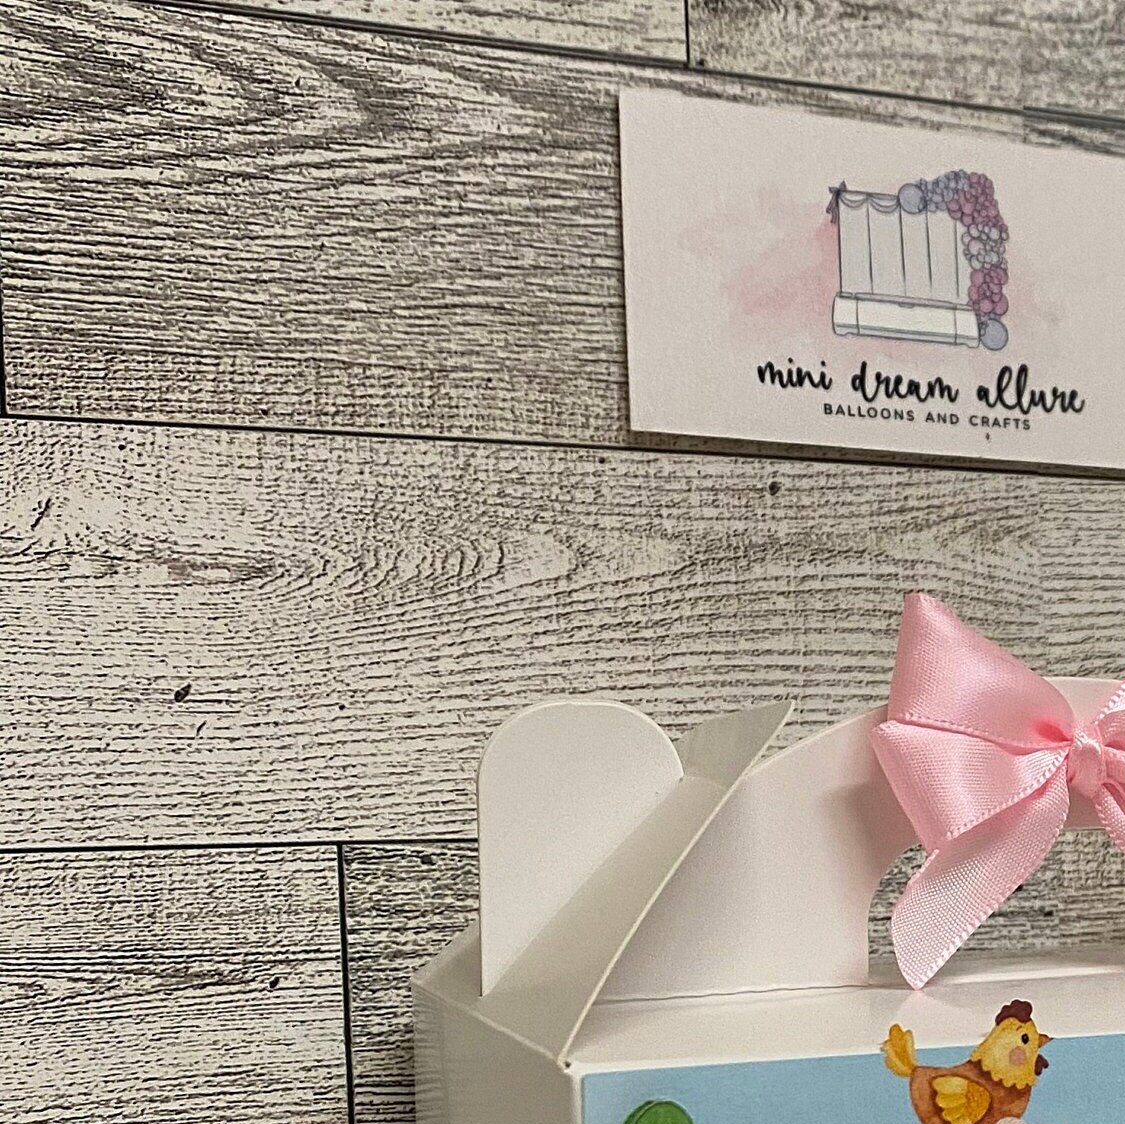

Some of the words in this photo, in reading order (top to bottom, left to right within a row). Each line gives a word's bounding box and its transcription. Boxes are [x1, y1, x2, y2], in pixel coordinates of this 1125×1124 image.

[757, 357, 833, 390] mini
[851, 361, 959, 402] dream
[976, 364, 1085, 415] allure
[823, 402, 915, 422] BALLOONS
[925, 411, 960, 425] AND
[969, 415, 1031, 431] CRAFTS
